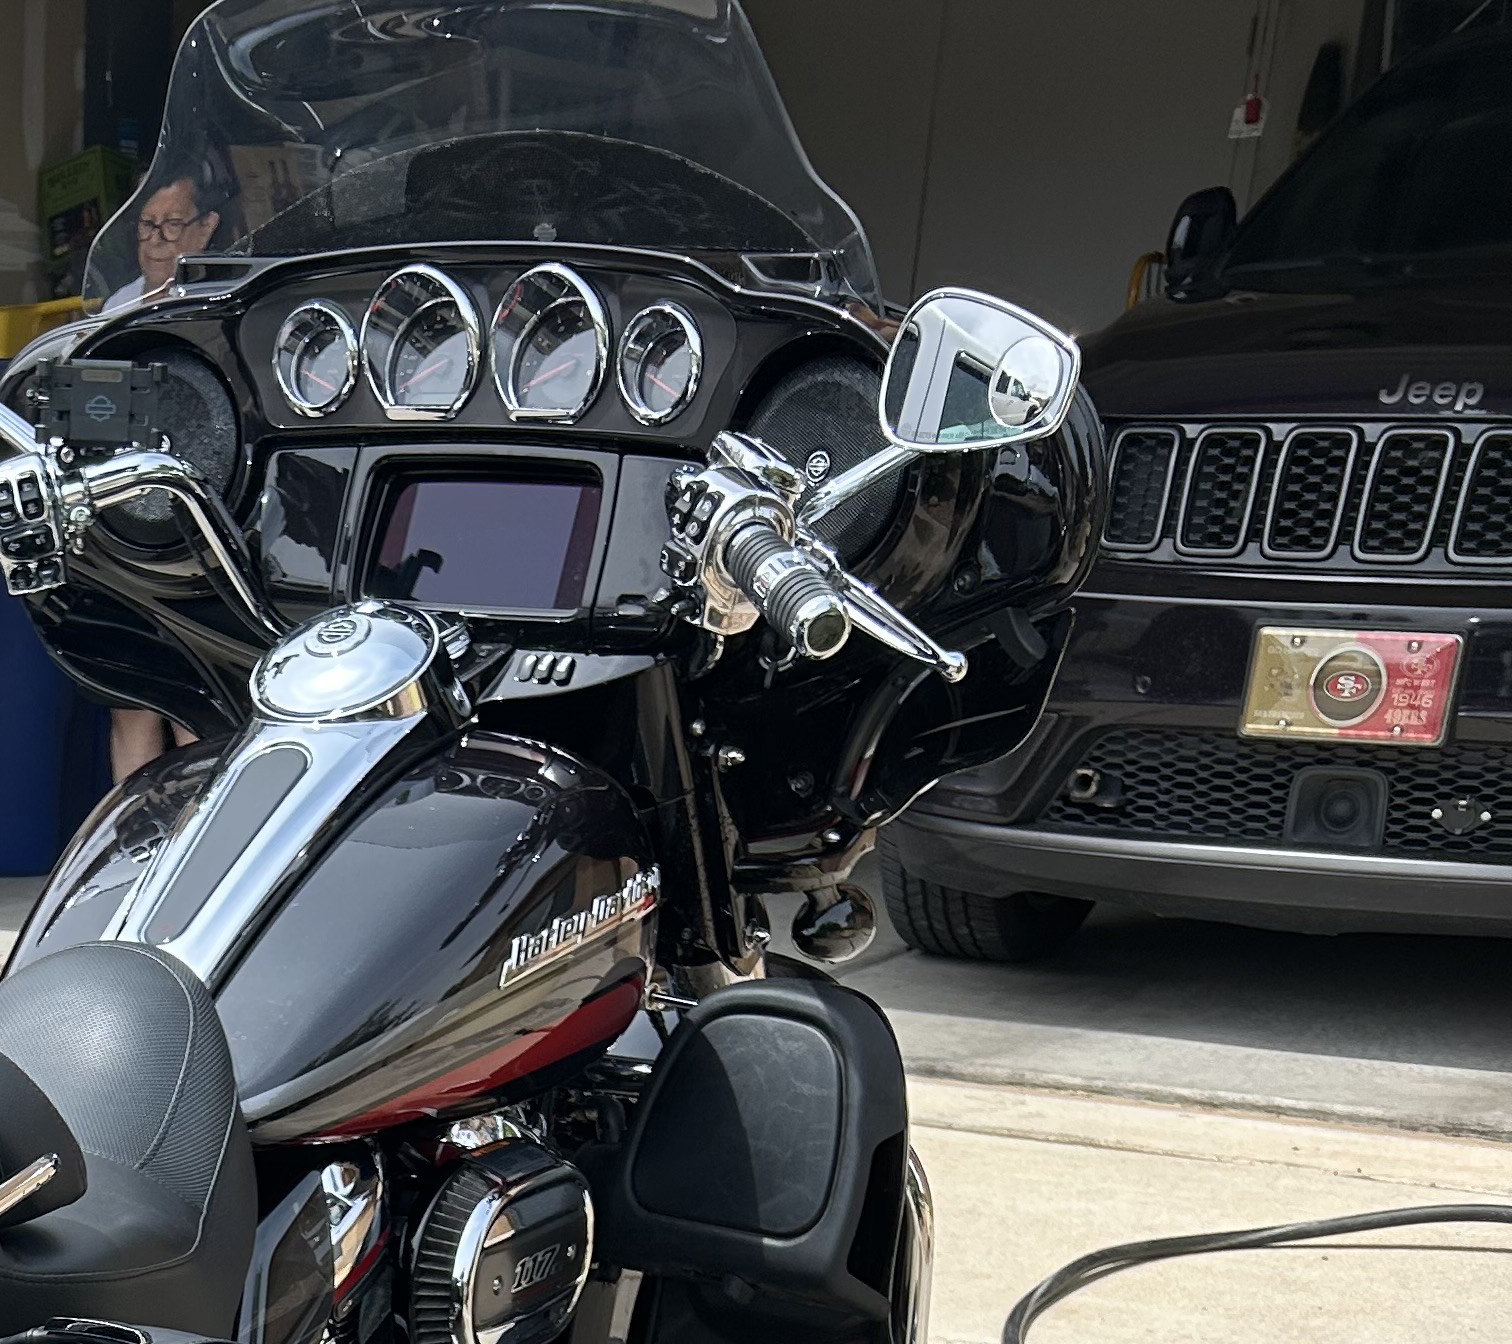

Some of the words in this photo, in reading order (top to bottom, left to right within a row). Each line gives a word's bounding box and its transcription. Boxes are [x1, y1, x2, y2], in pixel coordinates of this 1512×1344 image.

[1378, 372, 1485, 412] Jeep
[1392, 691, 1434, 708] 1946
[1384, 708, 1428, 726] 49ERS
